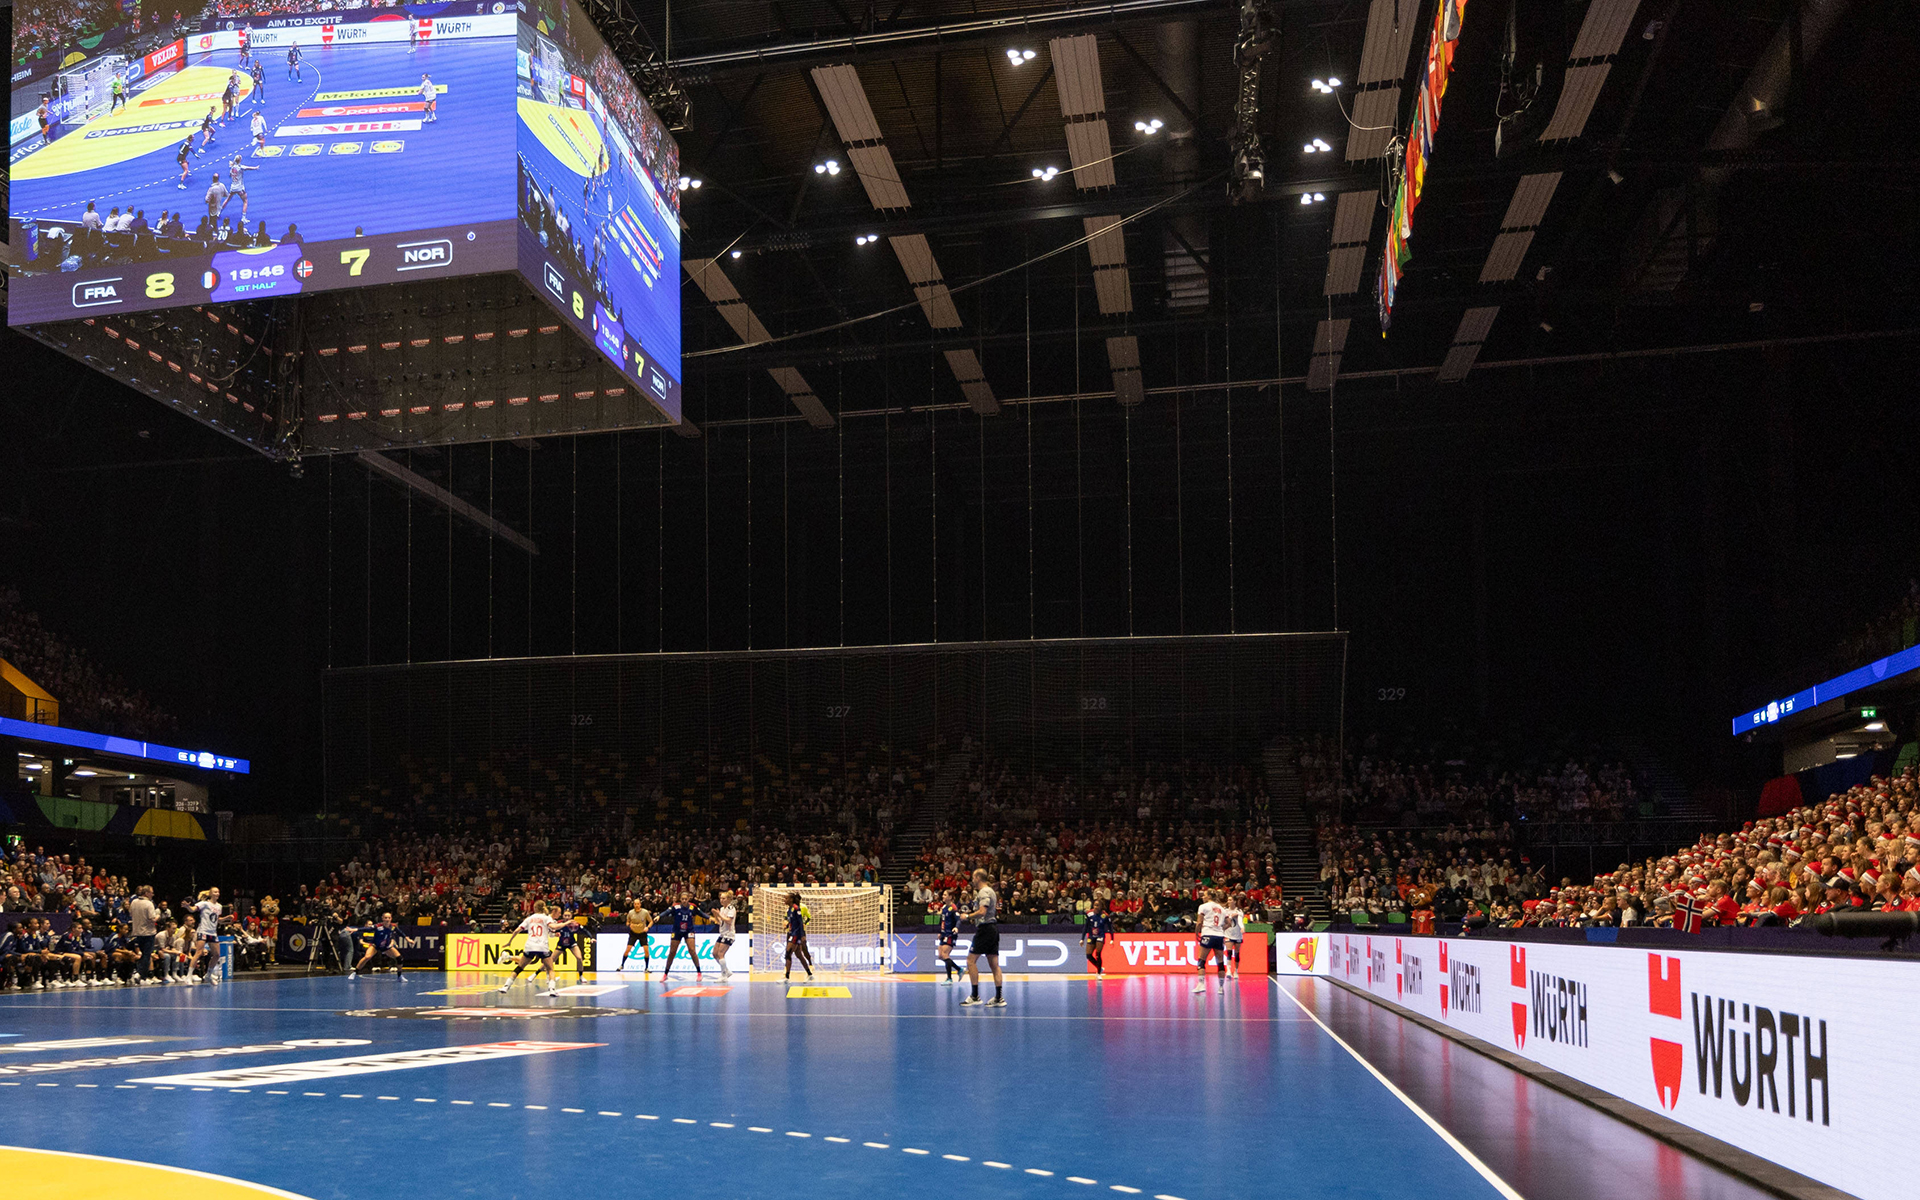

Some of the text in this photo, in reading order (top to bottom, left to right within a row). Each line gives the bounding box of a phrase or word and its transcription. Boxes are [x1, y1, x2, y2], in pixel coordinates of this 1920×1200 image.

[267, 16, 343, 28] AIM TO EXCITE
[151, 44, 178, 67] VELUX
[346, 105, 409, 116] posten
[340, 248, 370, 277] 7
[404, 247, 445, 263] NOR
[230, 265, 285, 281] 19:46
[84, 285, 117, 300] FRA
[145, 272, 175, 299] 8
[252, 281, 277, 291] HALF
[572, 290, 584, 320] 8
[634, 351, 645, 378] 7
[1378, 687, 1406, 701] 329
[826, 706, 850, 718] 327
[570, 714, 593, 726] 326
[530, 925, 543, 937] 10
[583, 937, 592, 966] Doors
